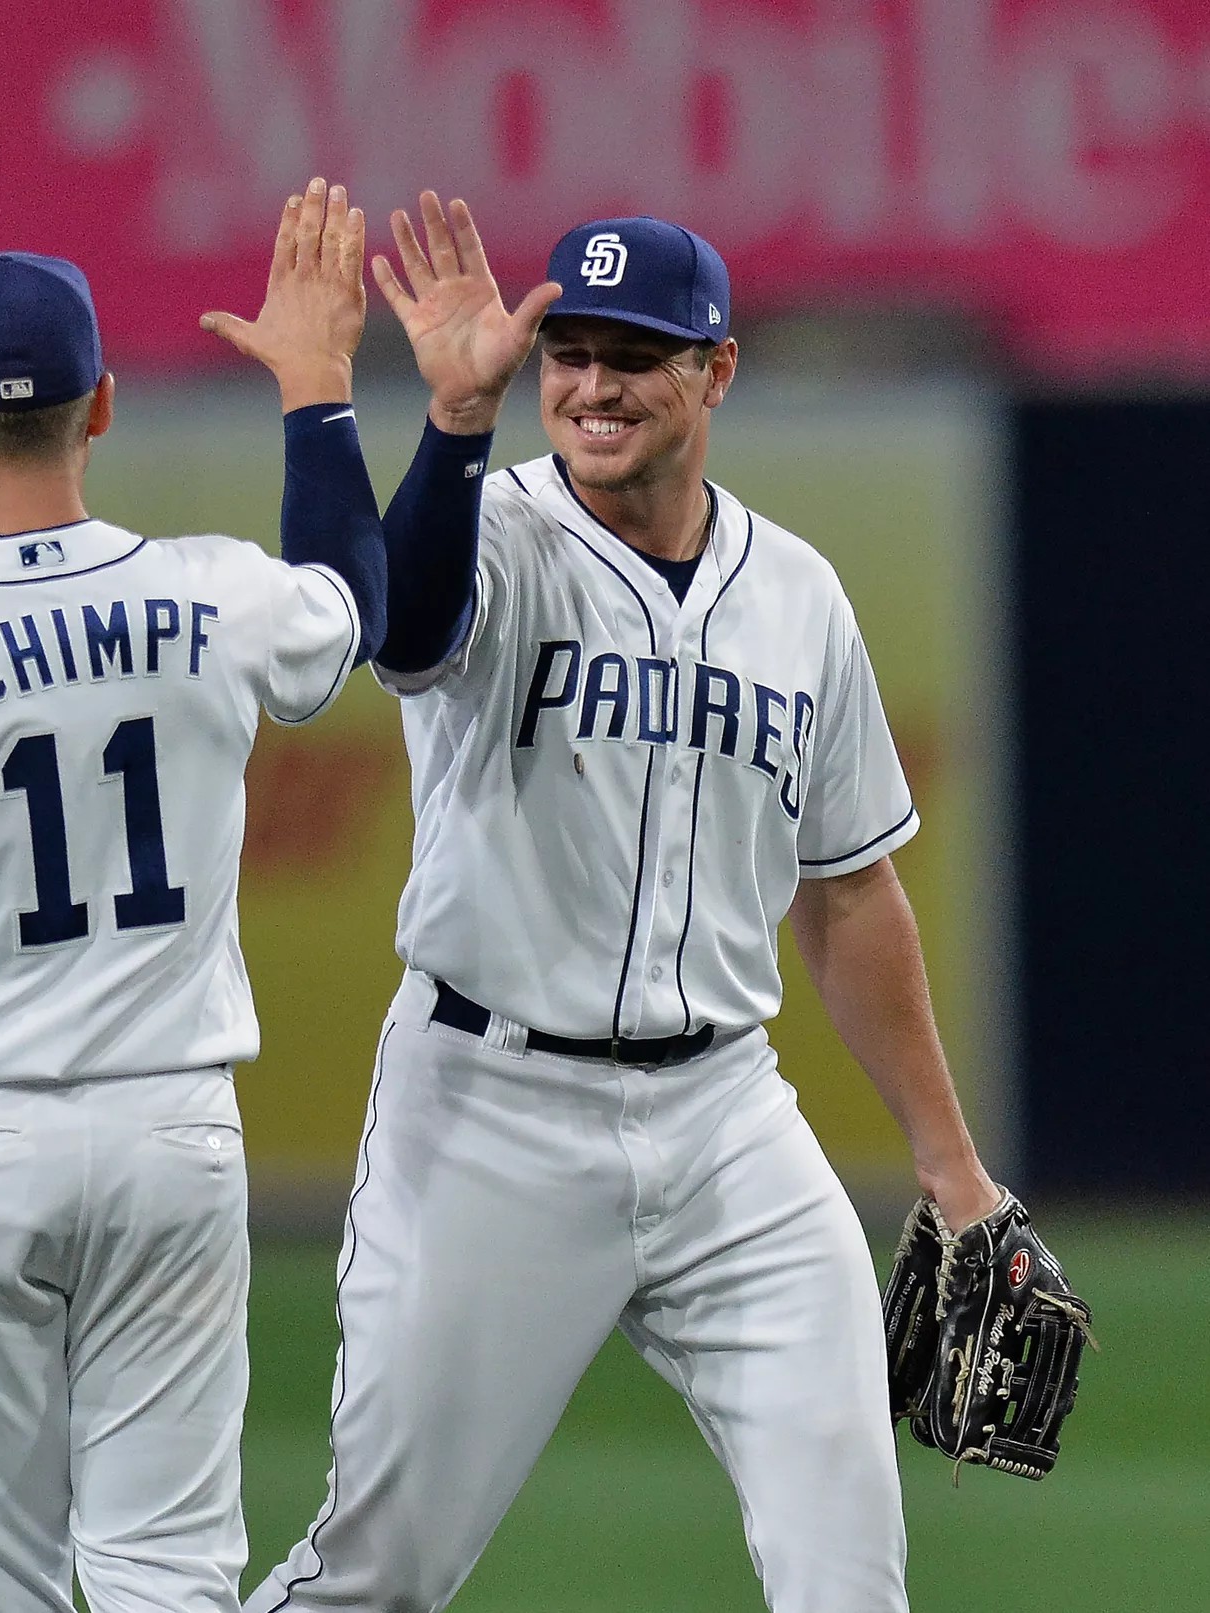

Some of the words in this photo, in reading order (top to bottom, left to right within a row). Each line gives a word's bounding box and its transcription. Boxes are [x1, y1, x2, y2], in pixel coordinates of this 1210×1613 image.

[580, 233, 628, 287] SD
[515, 640, 817, 822] PADRES
[0, 715, 188, 953] 11
